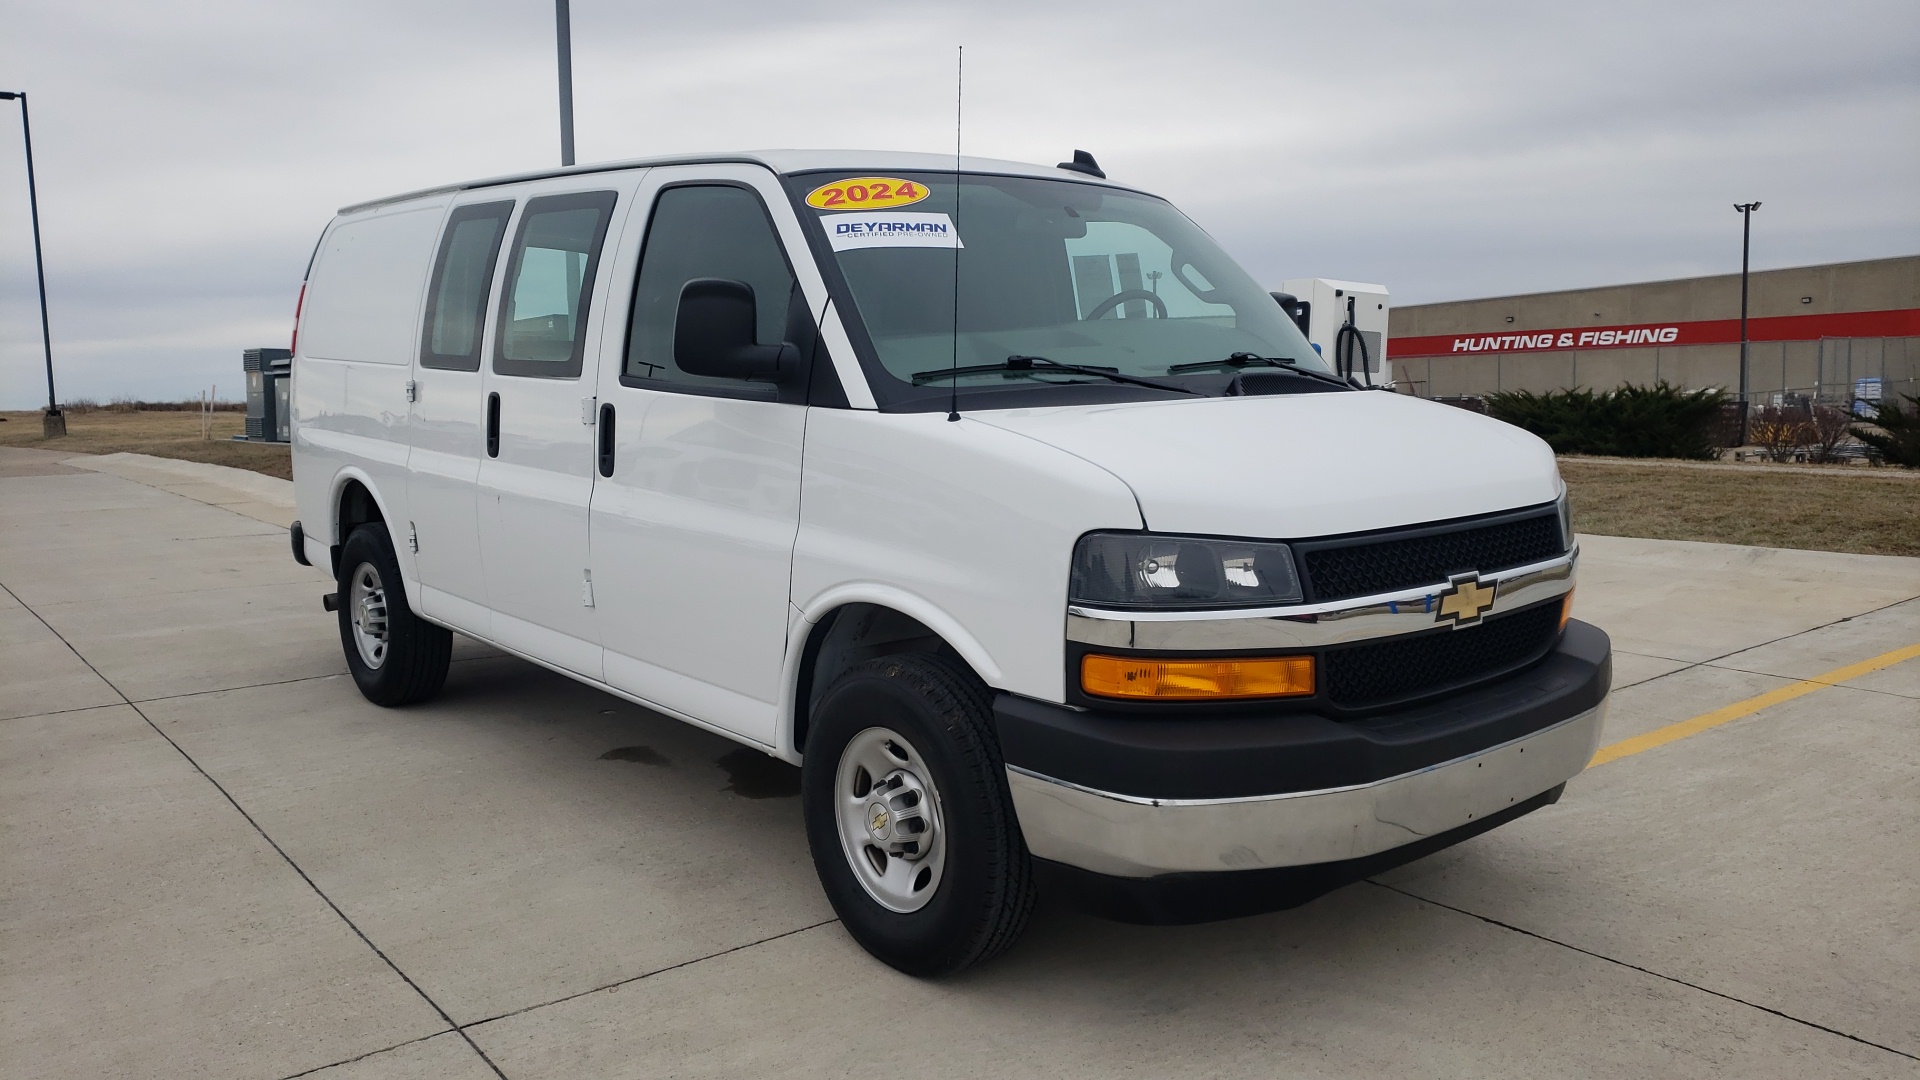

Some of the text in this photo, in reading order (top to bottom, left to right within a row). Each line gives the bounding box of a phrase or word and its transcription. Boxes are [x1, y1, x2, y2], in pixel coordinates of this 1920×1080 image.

[821, 182, 918, 206] 2024
[836, 222, 947, 234] DEYARMAN
[1452, 327, 1679, 351] HUNTING & FISHING
